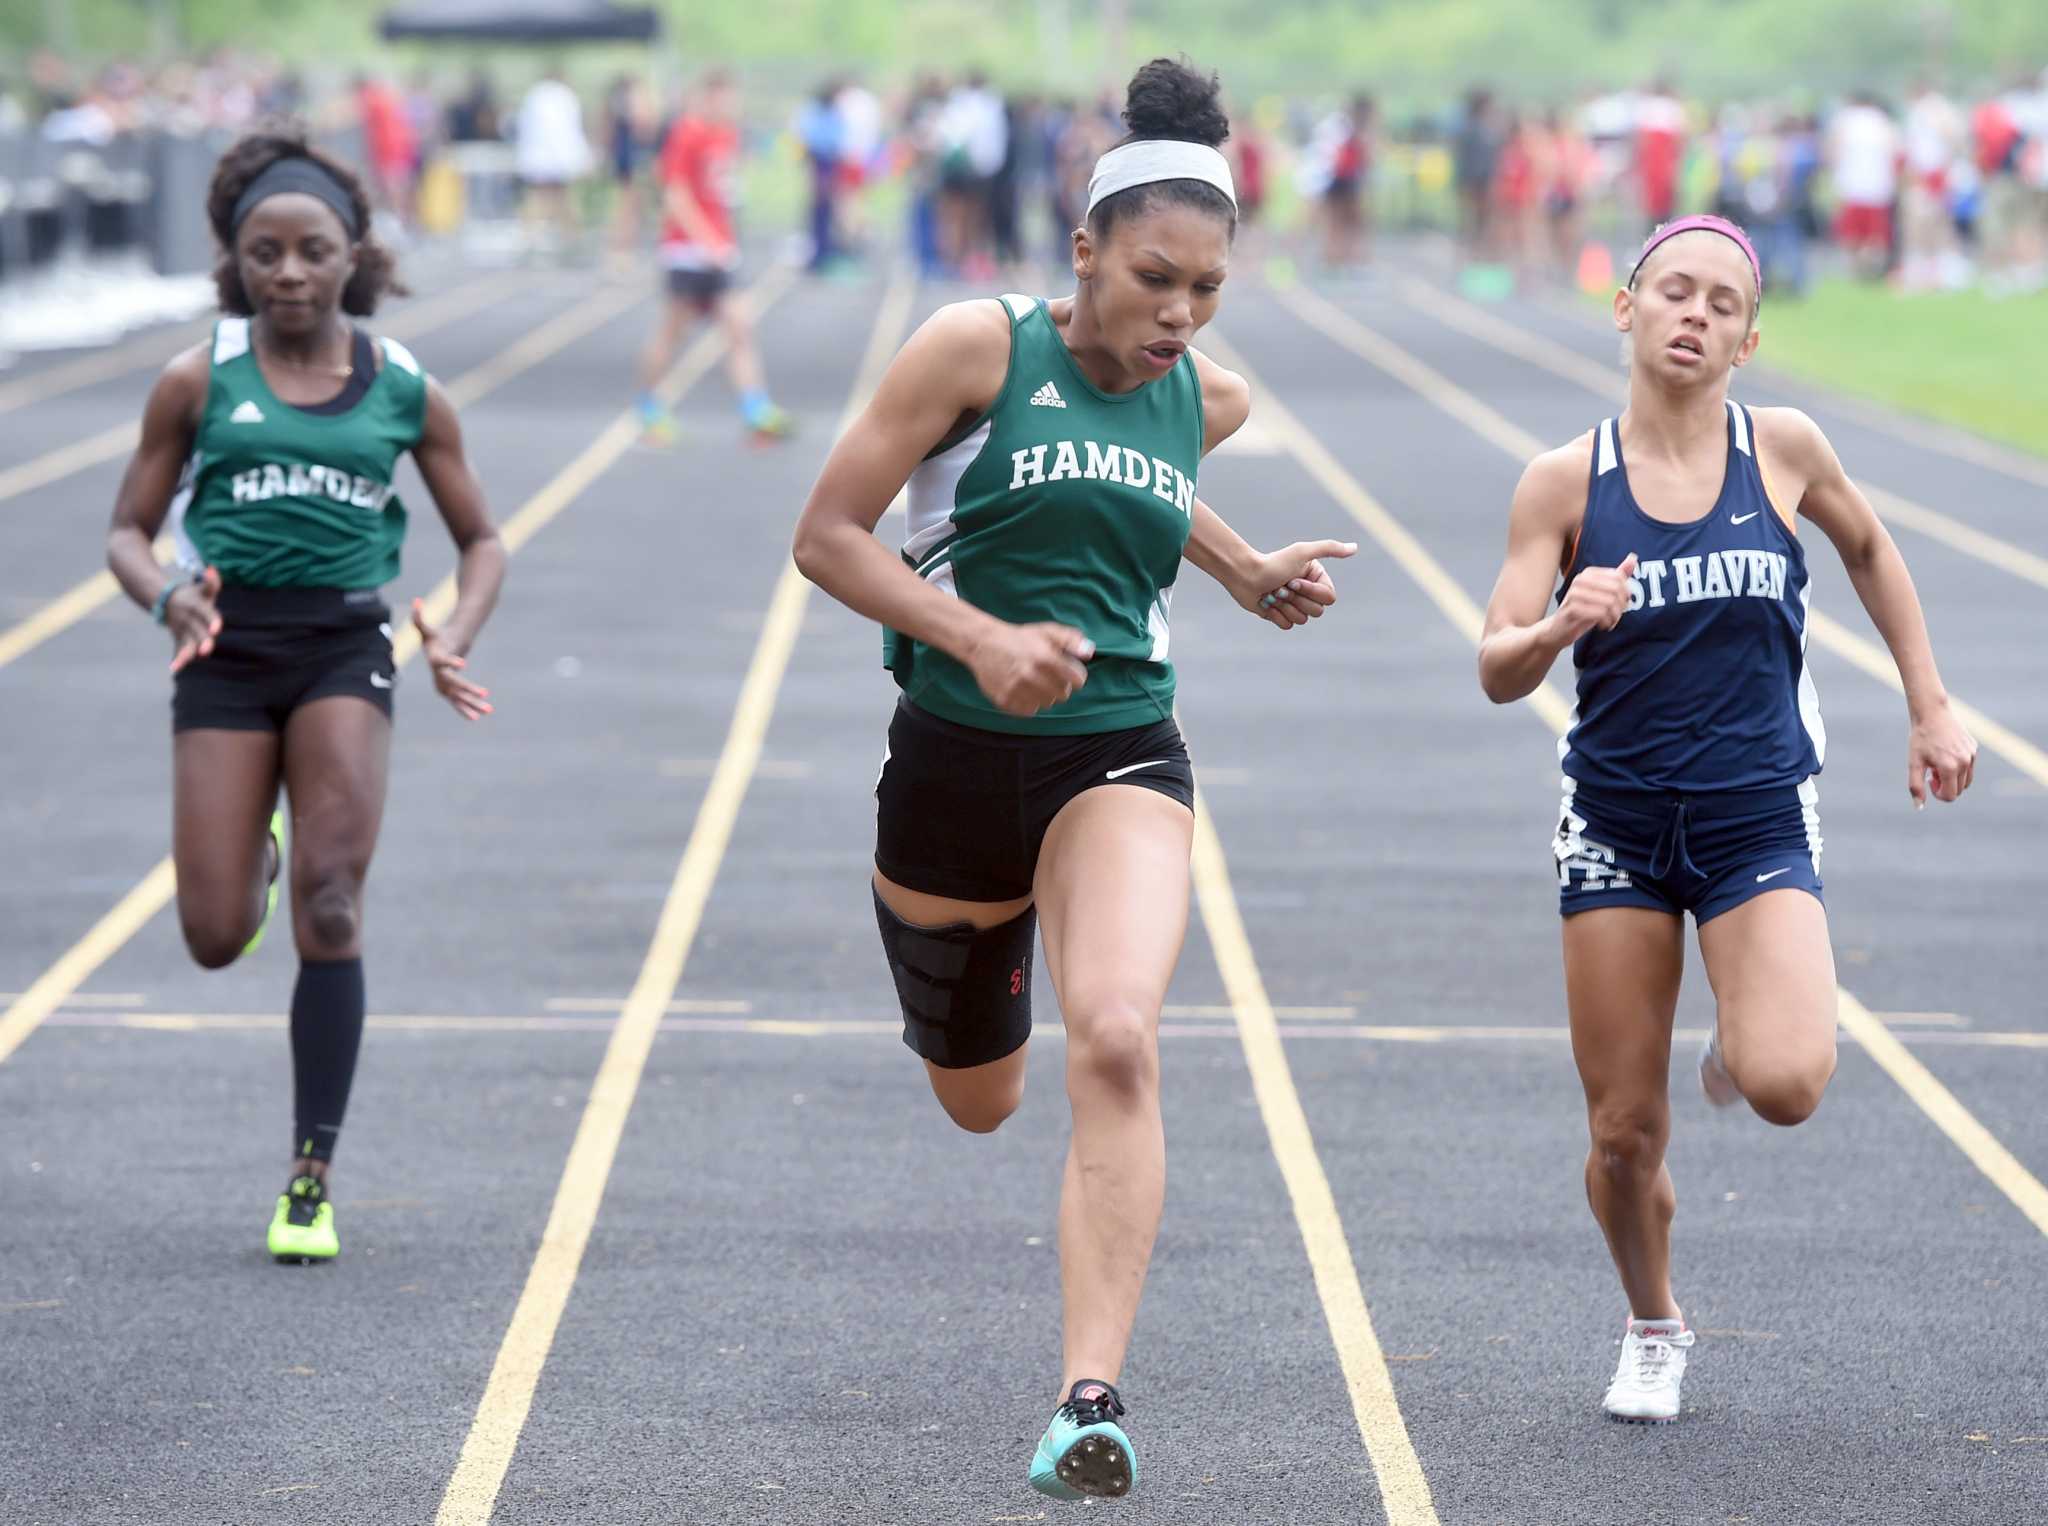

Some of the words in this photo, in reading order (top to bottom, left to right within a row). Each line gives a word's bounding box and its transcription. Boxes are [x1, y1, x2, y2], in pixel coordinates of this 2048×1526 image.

[1030, 396, 1067, 409] adidas
[1009, 440, 1196, 520] HAMDEN
[1625, 559, 1667, 613] ST
[1672, 549, 1787, 602] HAVEN
